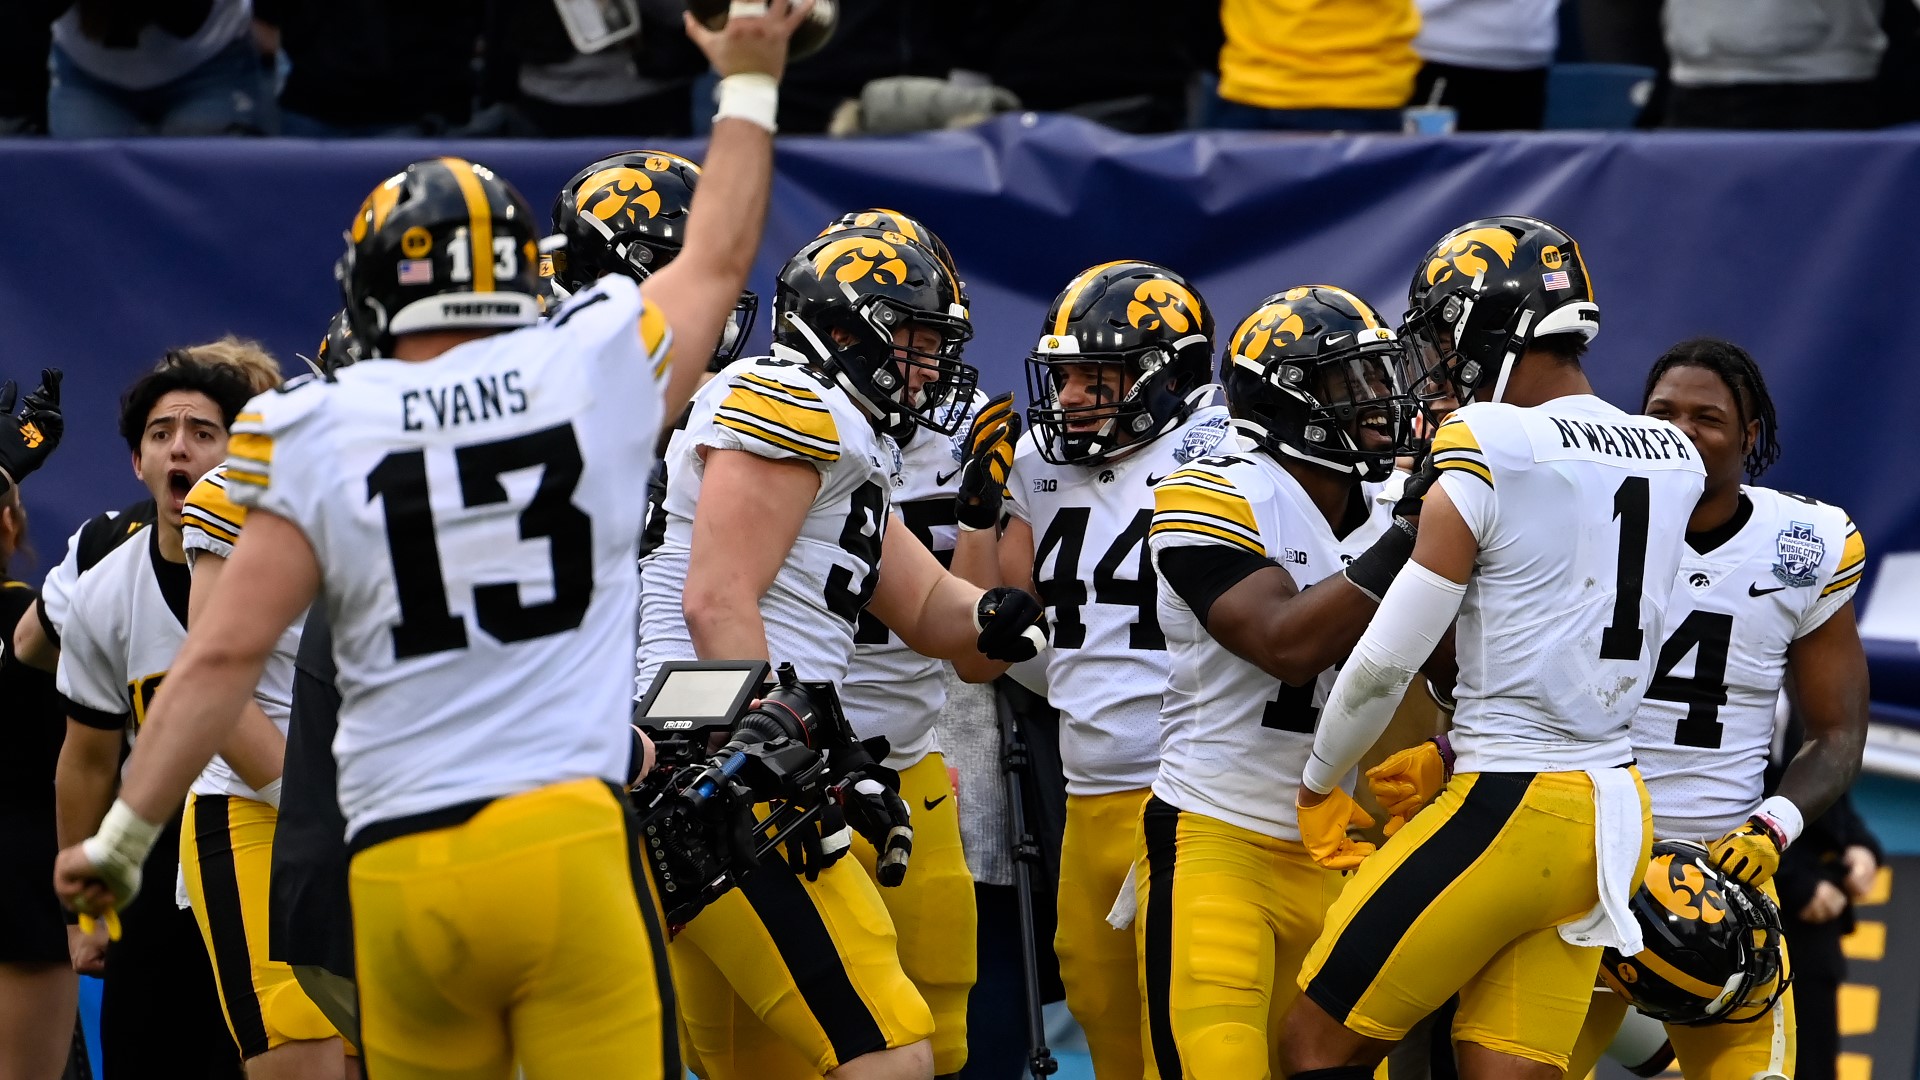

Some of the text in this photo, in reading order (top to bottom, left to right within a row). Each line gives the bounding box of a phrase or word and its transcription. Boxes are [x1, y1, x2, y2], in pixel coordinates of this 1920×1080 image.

[402, 370, 529, 432] EVANS
[1549, 416, 1691, 460] NWANKPA
[366, 418, 594, 663] 13
[824, 480, 884, 624] 9
[1033, 507, 1167, 650] 44
[1599, 476, 1649, 660] 1
[1780, 542, 1822, 562] MUSIC CITY
[1788, 553, 1810, 567] BOWL
[1643, 609, 1734, 749] 4
